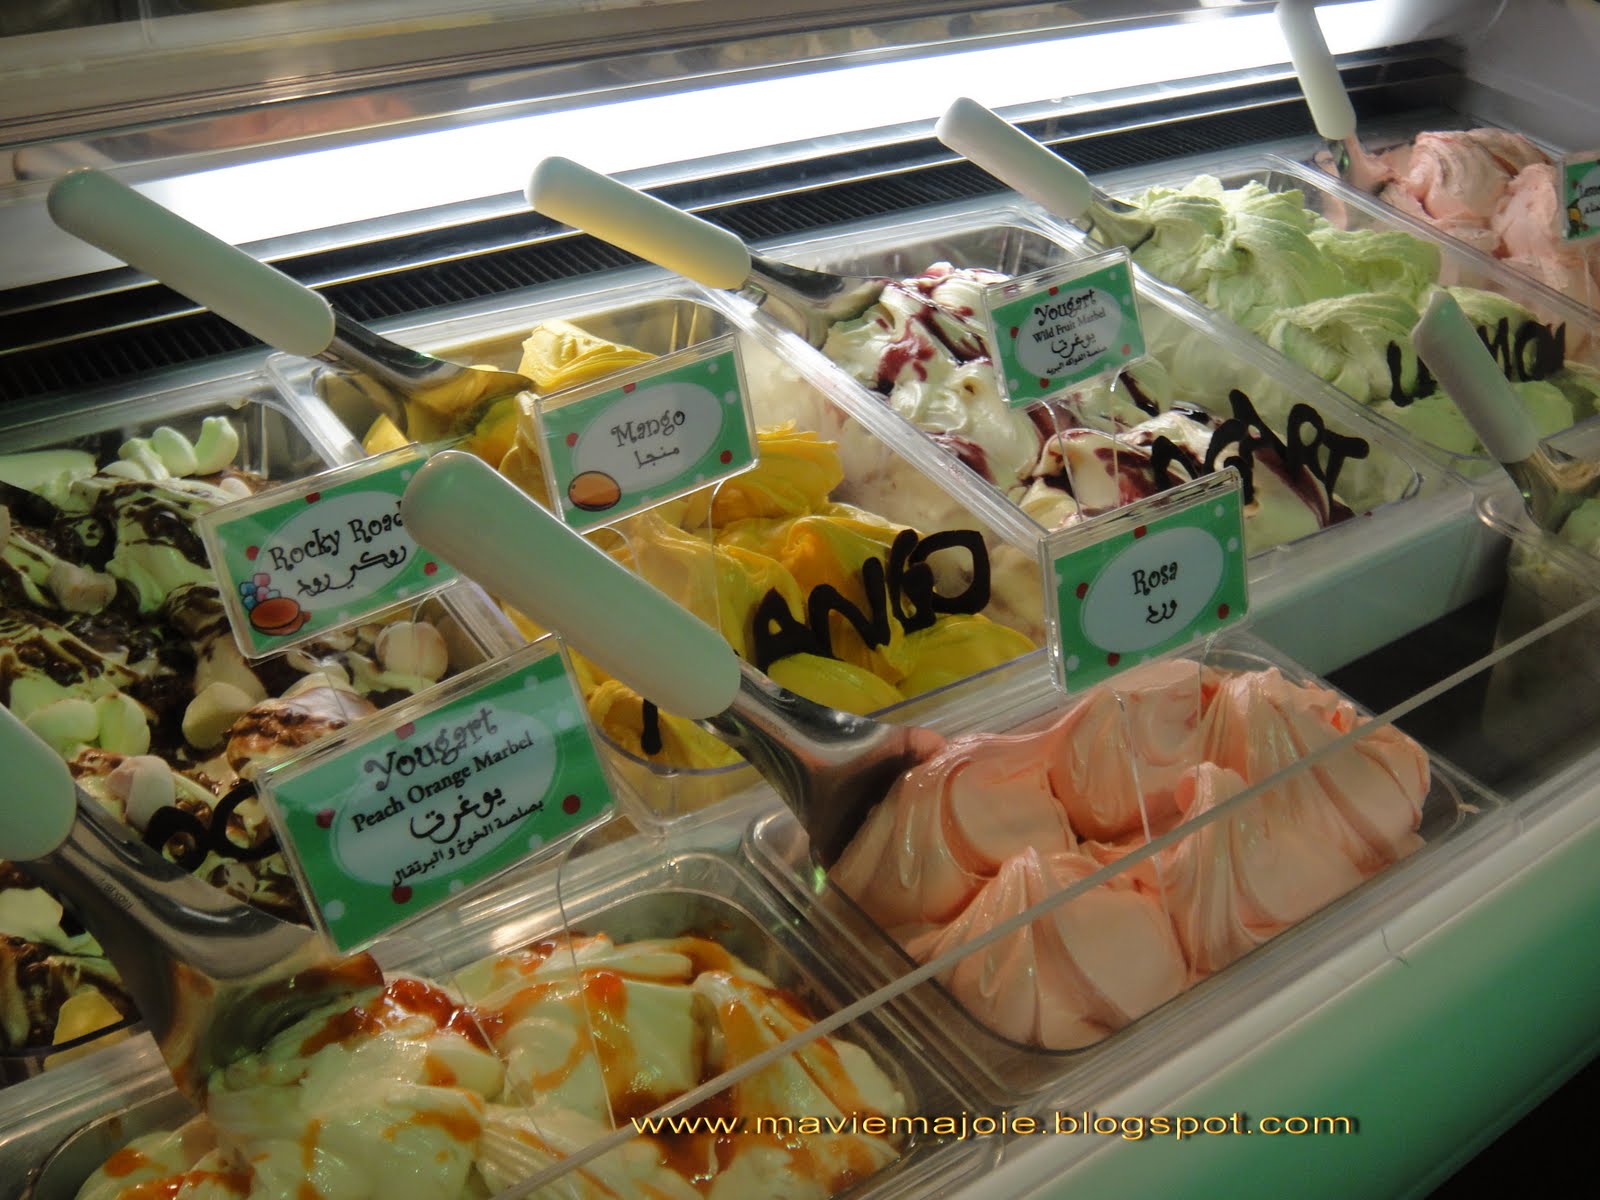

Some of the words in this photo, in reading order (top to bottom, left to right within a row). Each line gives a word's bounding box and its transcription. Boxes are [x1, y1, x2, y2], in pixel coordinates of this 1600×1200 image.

[1034, 289, 1096, 326] Yougart
[1032, 327, 1055, 343] Wild
[1056, 320, 1077, 335] Fruit
[611, 410, 685, 447] Mango
[634, 447, 680, 469] منجا
[268, 528, 340, 571] Rocky
[1131, 561, 1178, 596] Rosa
[1145, 599, 1178, 624] ورد
[364, 706, 499, 792] Yougart
[352, 798, 406, 834] Peach
[407, 766, 471, 805] Orange
[472, 731, 534, 773] Marbel
[457, 823, 494, 855] الخوخ
[393, 850, 444, 887] البرتقال
